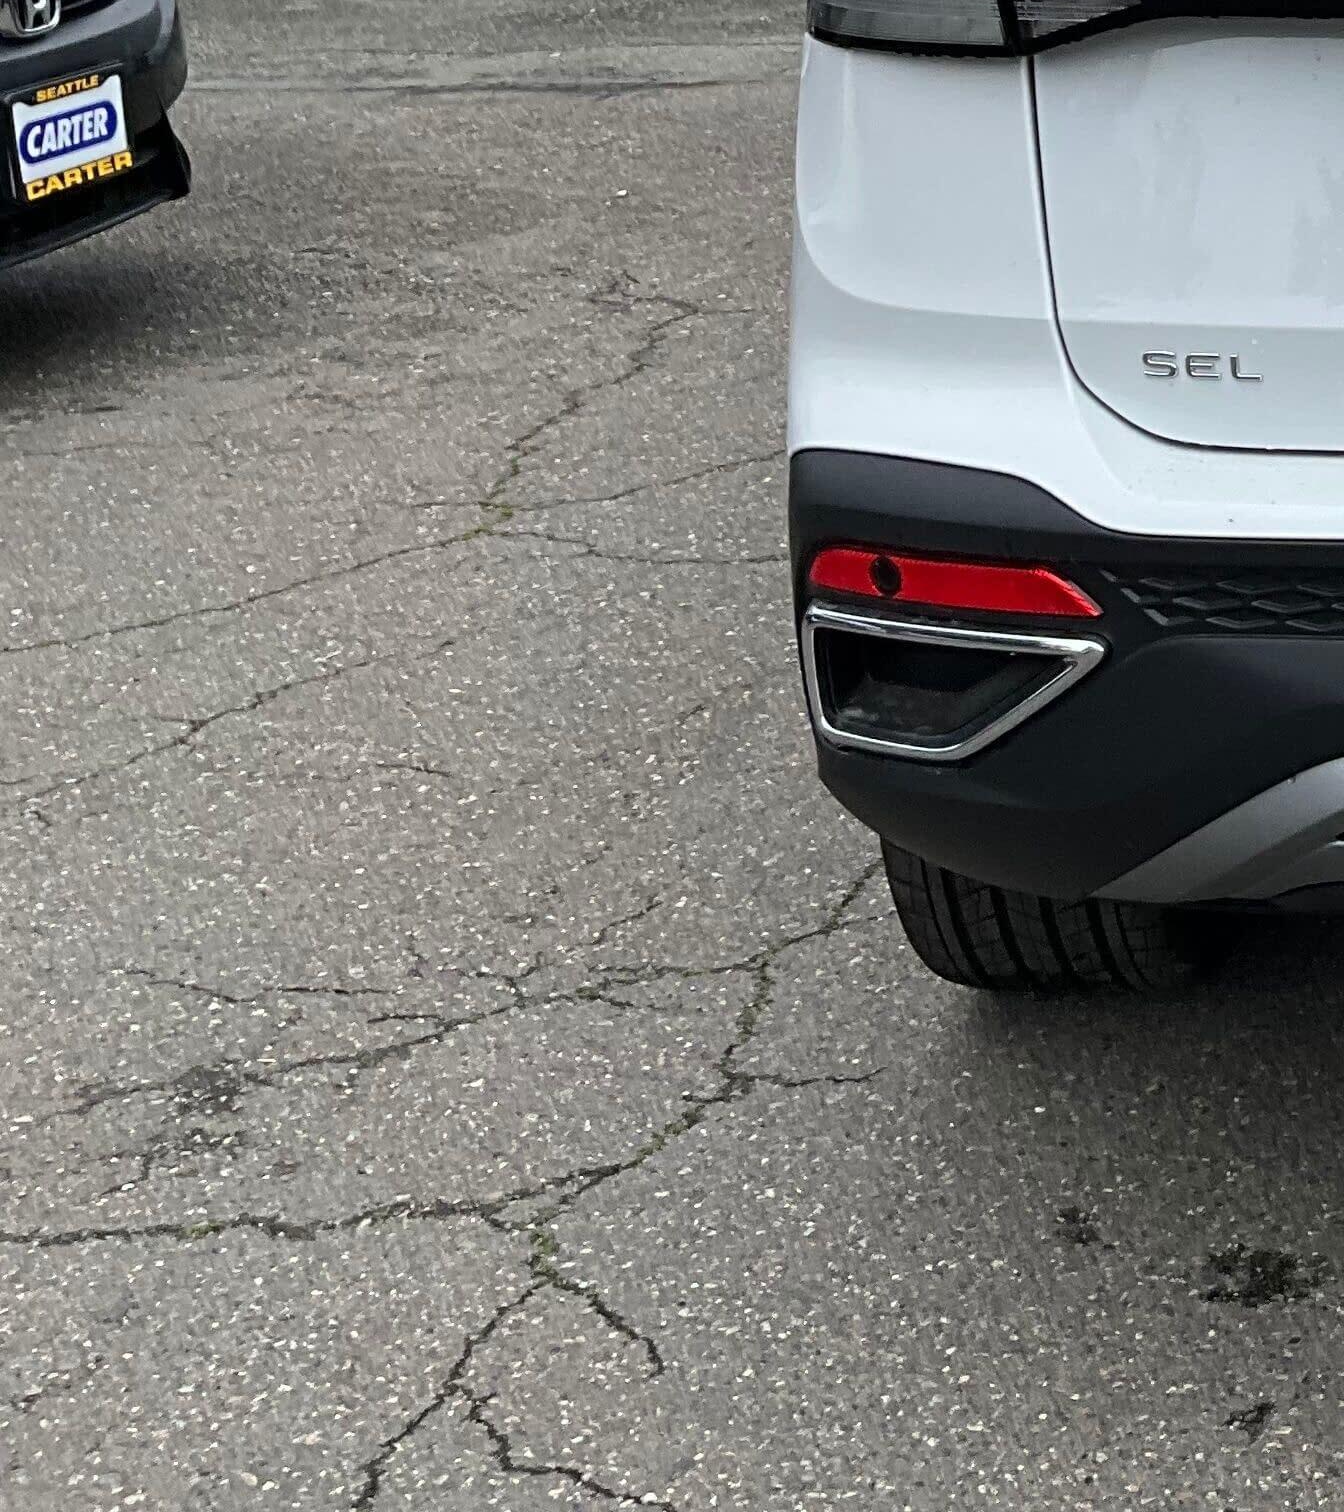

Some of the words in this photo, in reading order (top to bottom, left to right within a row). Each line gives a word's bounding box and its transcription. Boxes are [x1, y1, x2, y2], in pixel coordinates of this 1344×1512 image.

[36, 74, 99, 102] SEATTLE
[26, 107, 108, 158] CARTER
[25, 151, 133, 201] CARTER
[1142, 350, 1264, 380] SEL
